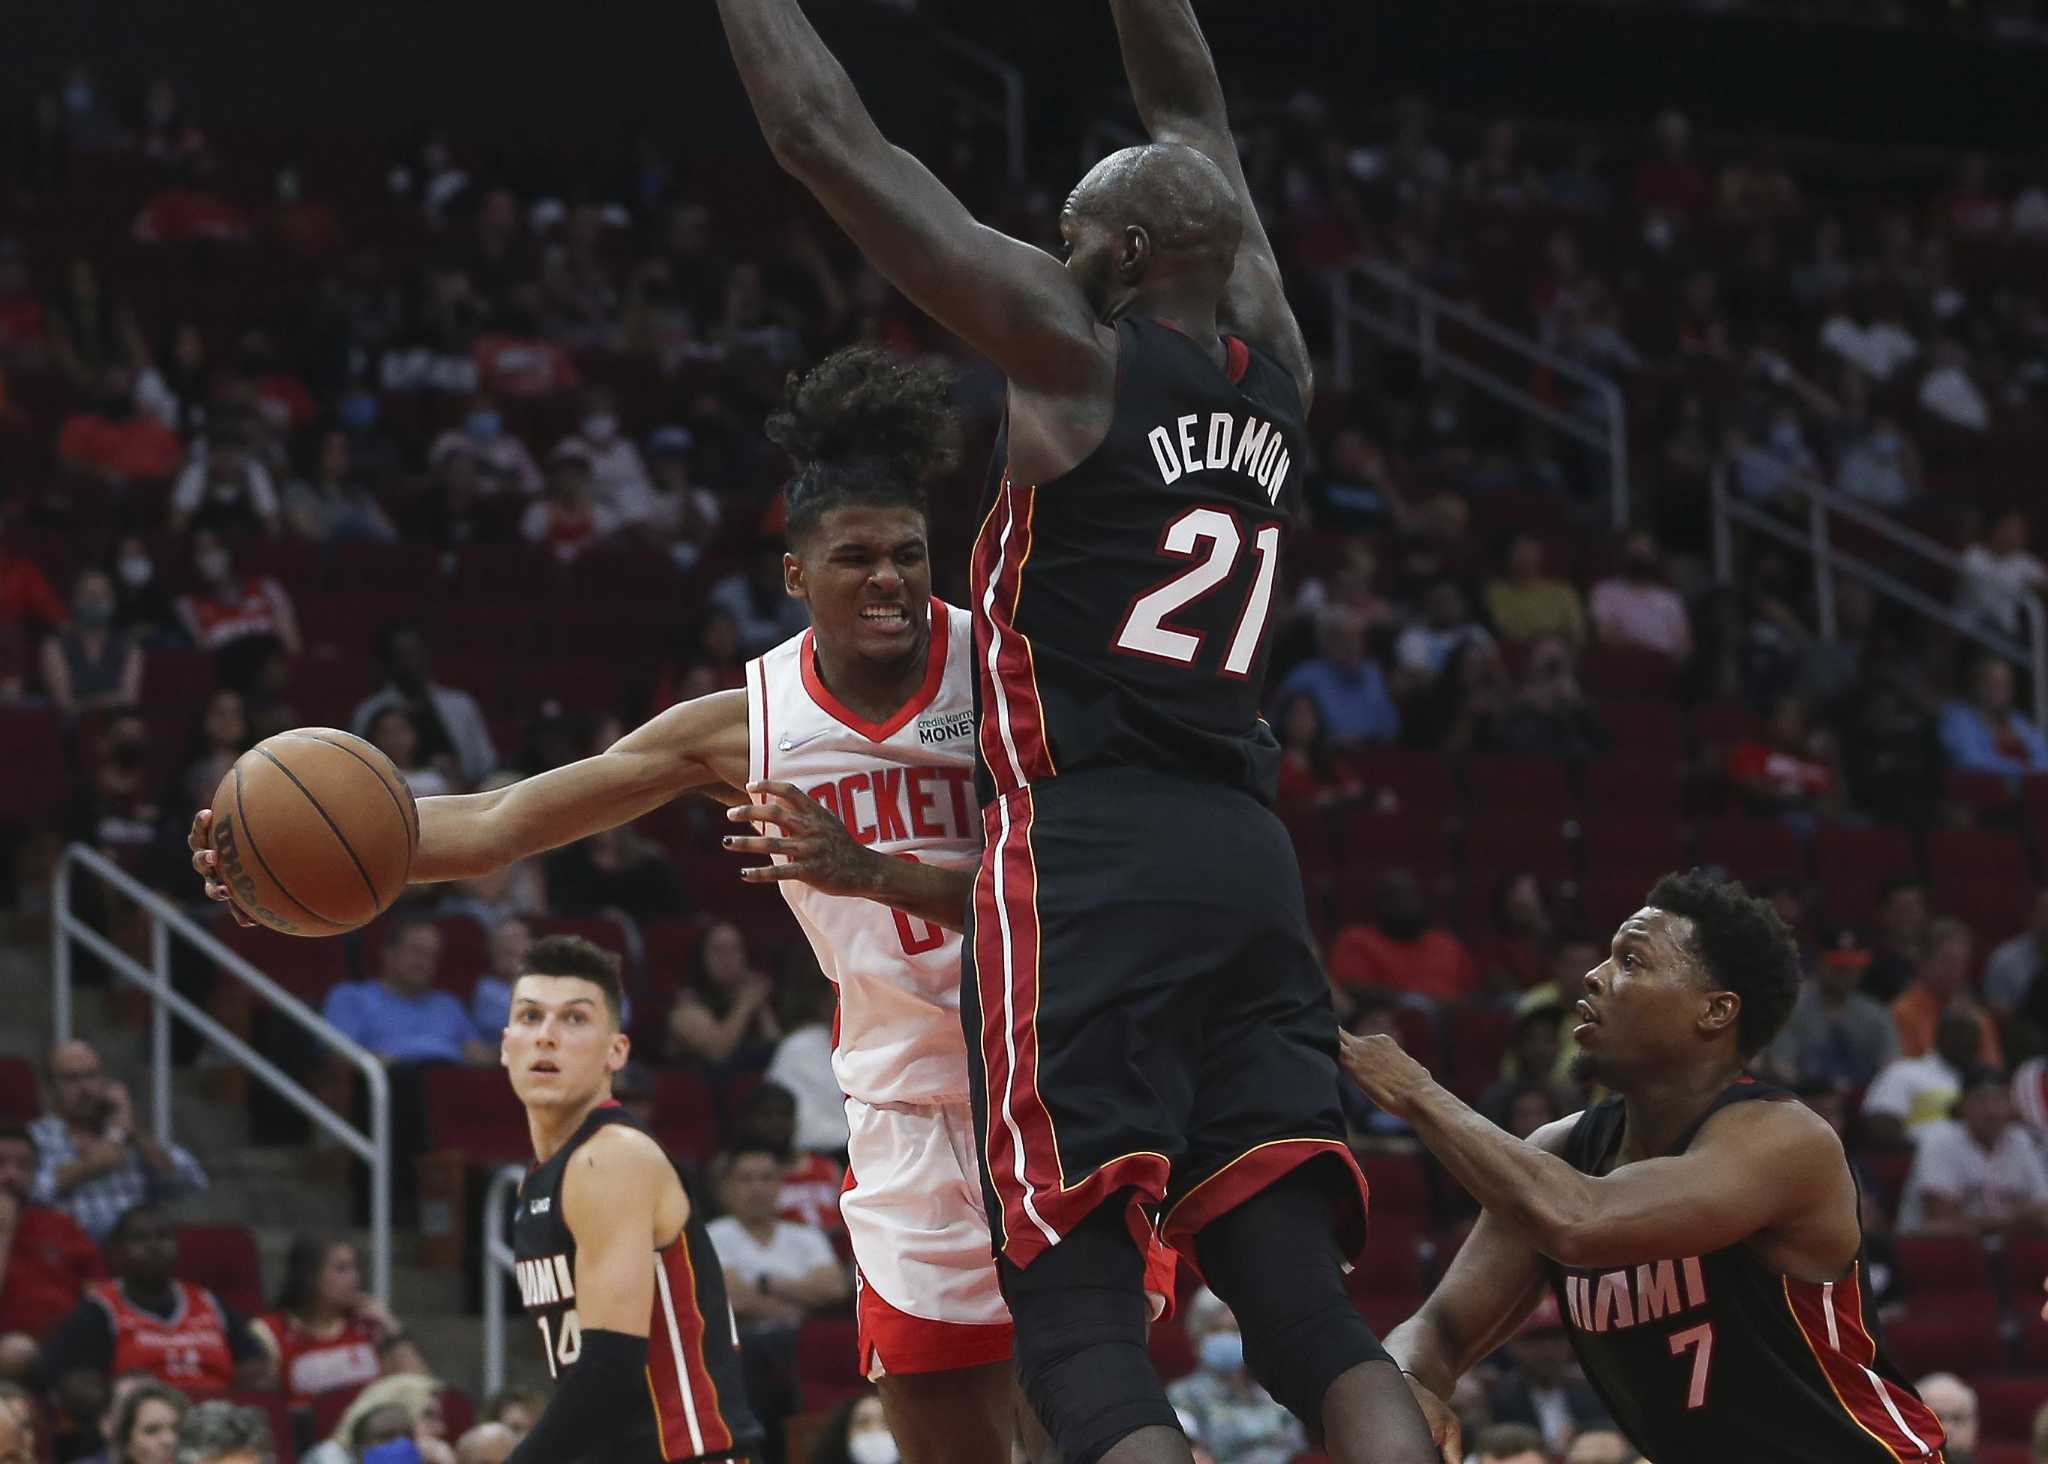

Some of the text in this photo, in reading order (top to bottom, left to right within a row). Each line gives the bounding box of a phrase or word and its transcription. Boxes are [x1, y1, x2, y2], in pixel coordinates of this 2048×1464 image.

[1147, 412, 1290, 506] DEDMON
[1115, 507, 1281, 676] 21
[918, 715, 945, 729] credit
[1668, 1321, 1713, 1410] 7
